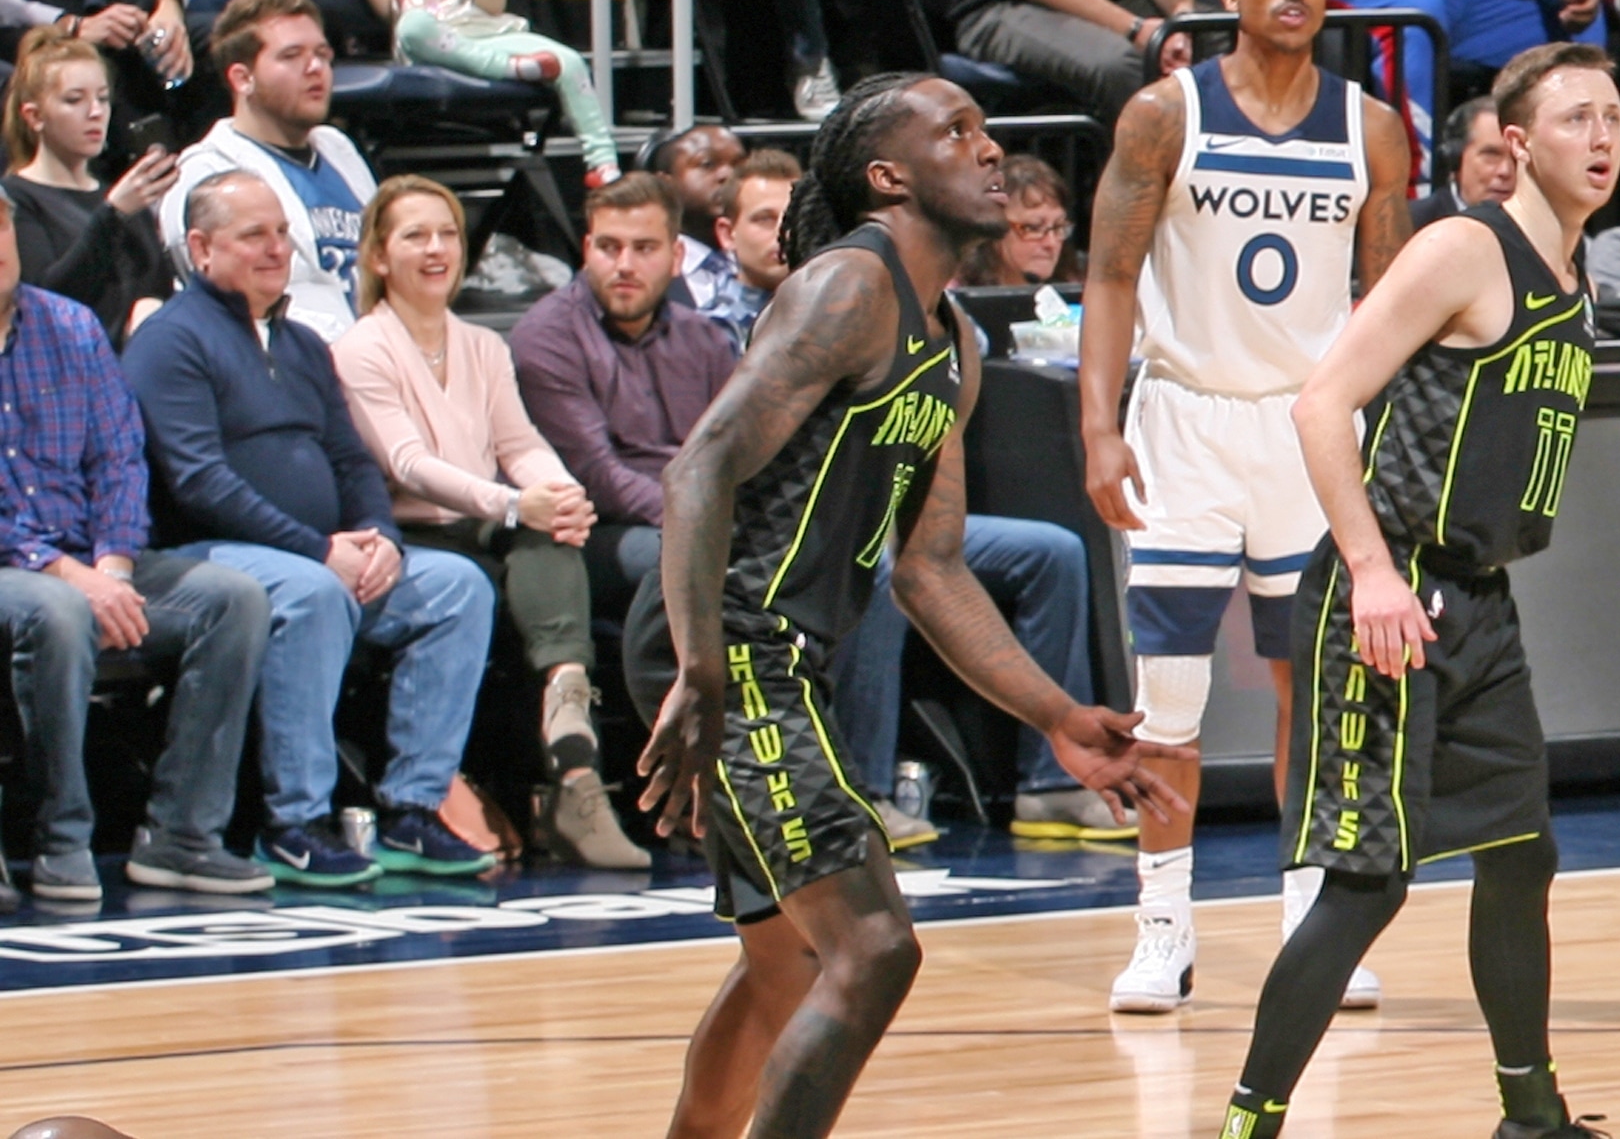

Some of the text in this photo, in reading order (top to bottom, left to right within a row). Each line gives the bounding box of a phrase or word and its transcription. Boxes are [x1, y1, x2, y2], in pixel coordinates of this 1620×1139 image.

[1189, 184, 1353, 223] WOLVES
[1236, 232, 1299, 307] 0
[1519, 407, 1576, 517] 11
[727, 643, 812, 863] HAWKS
[1333, 634, 1367, 851] AWKS
